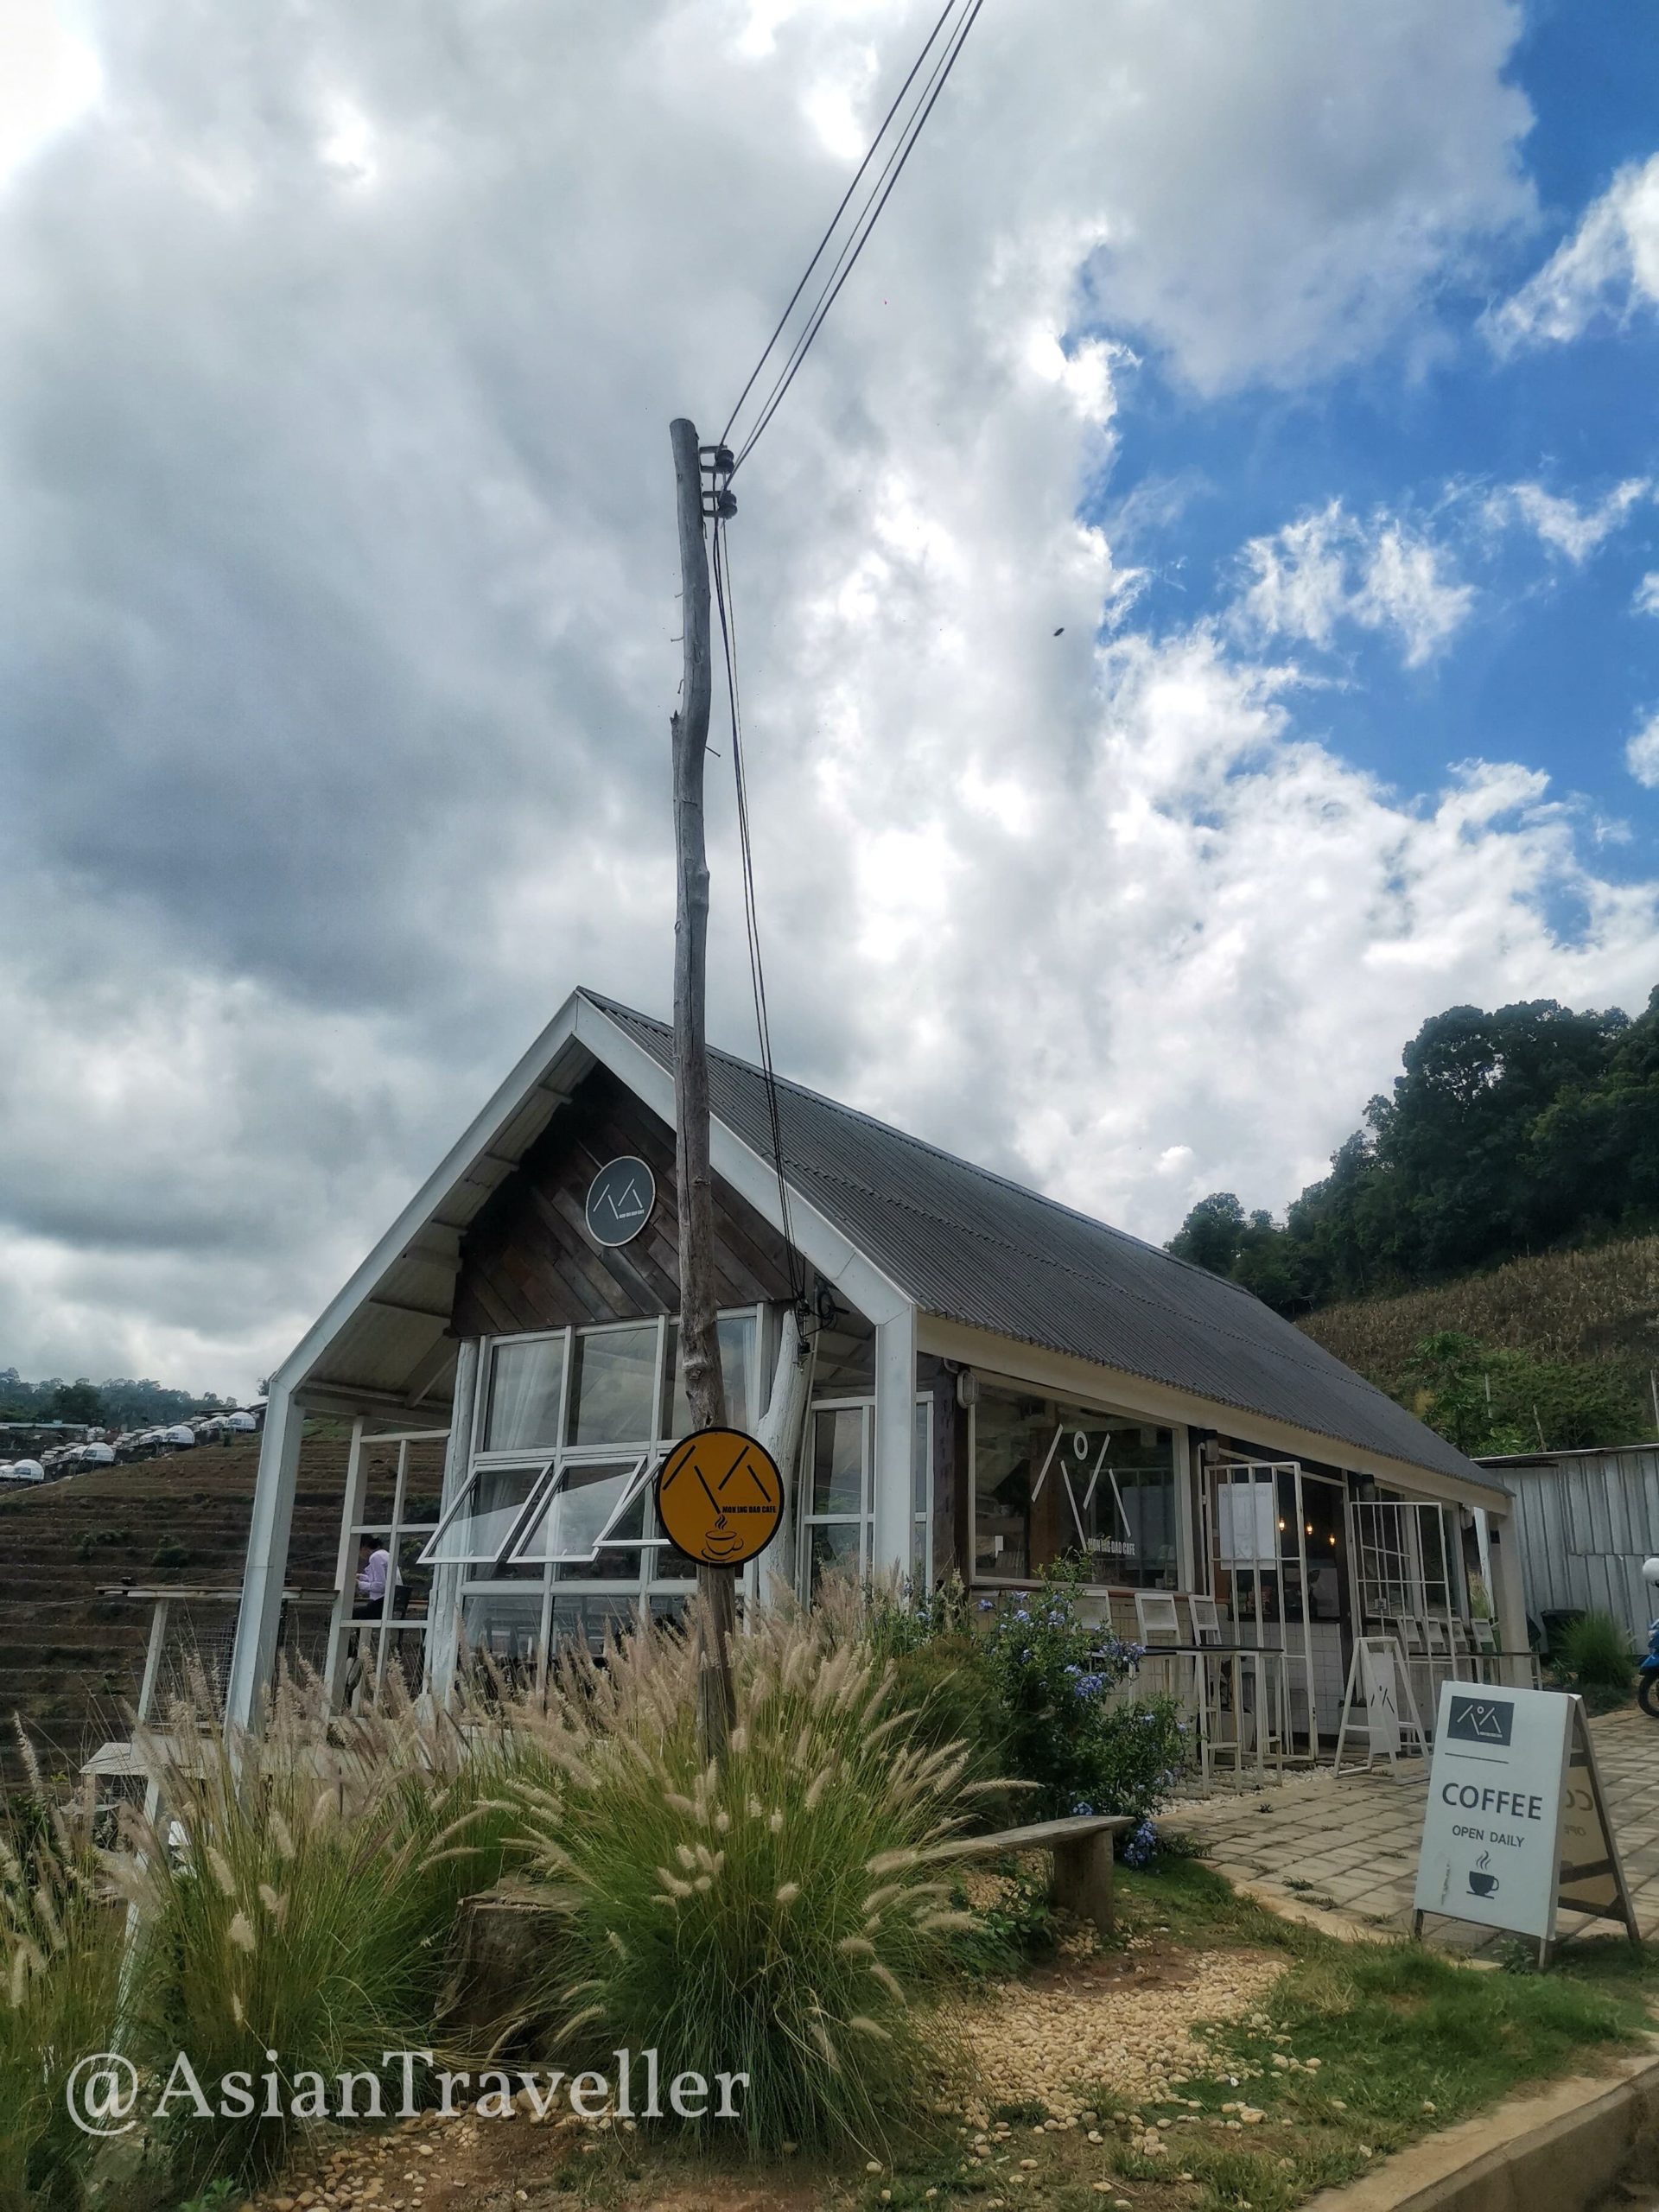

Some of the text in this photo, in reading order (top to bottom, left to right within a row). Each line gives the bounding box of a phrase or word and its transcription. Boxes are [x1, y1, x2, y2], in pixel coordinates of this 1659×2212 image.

[762, 1505, 777, 1514] CAFE
[1123, 1542, 1135, 1555] CAFE
[1442, 1783, 1542, 1821] COFFEE
[1452, 1825, 1525, 1848] OPEN DAILY
